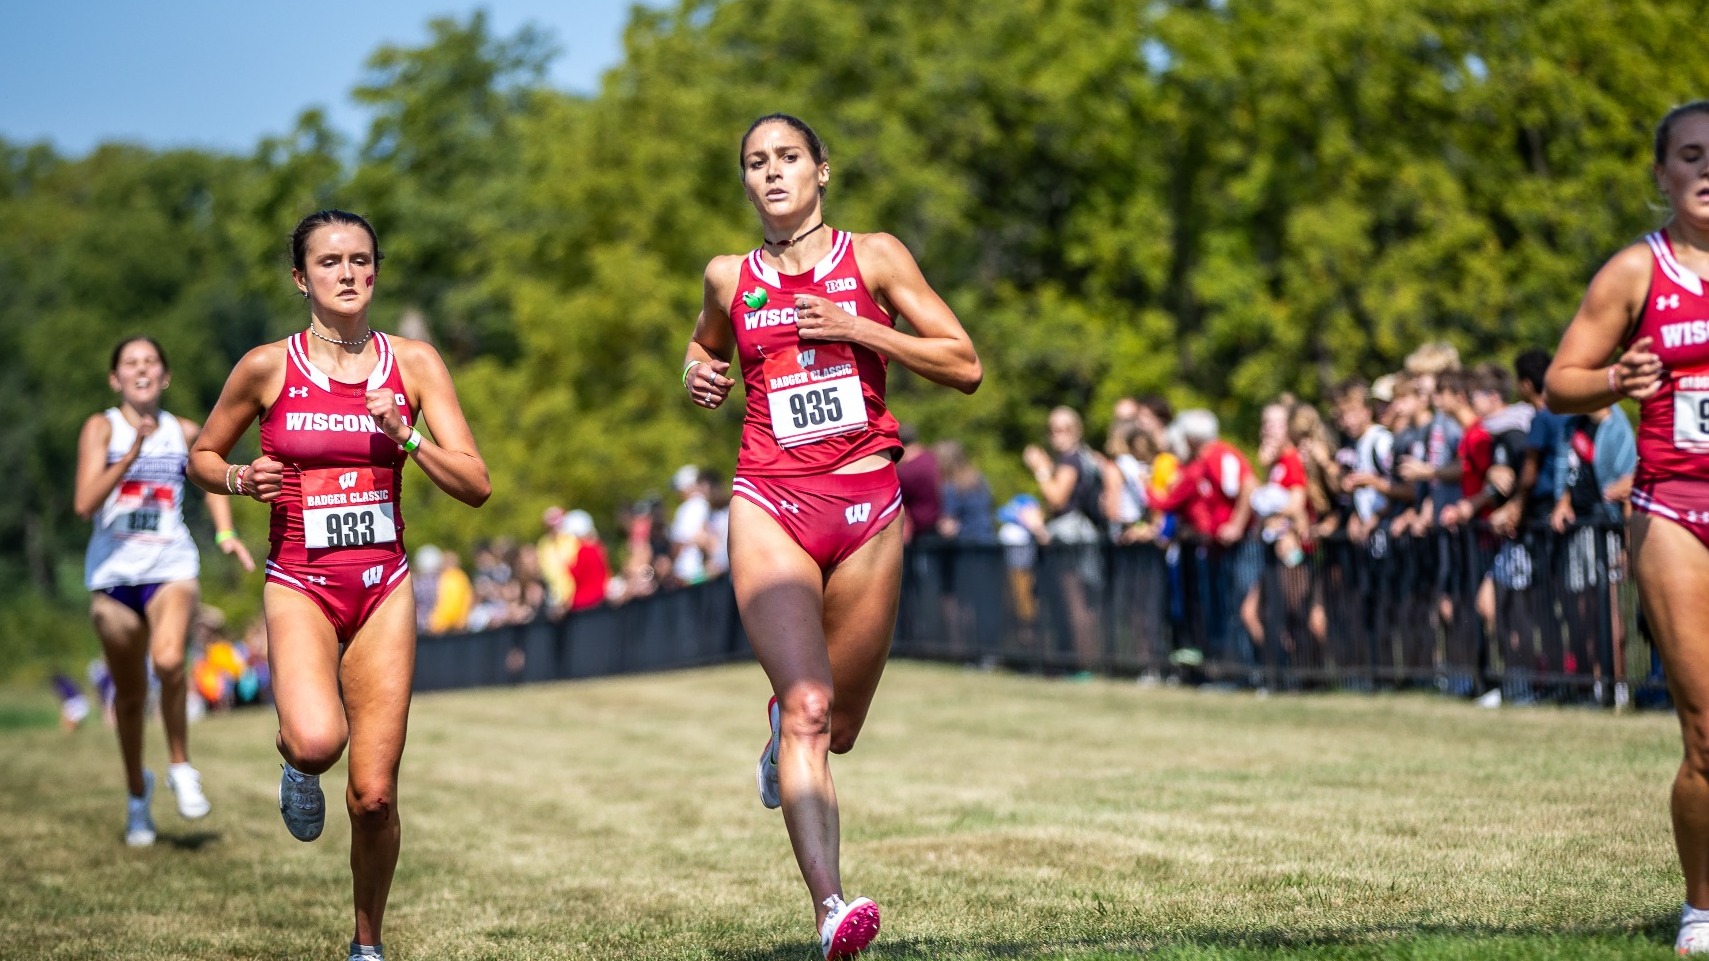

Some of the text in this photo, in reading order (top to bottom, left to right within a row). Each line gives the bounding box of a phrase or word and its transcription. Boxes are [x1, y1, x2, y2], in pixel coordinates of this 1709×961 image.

[744, 301, 857, 330] WISCN
[1660, 320, 1709, 348] WIS
[797, 349, 816, 369] W
[769, 363, 853, 390] BADGER CLASSIC
[789, 386, 843, 429] 935
[286, 412, 407, 433] WISCON
[338, 471, 358, 490] W
[306, 489, 389, 507] BADGER CLASSIC
[844, 503, 872, 525] W
[326, 510, 375, 547] 933
[362, 565, 384, 588] W
